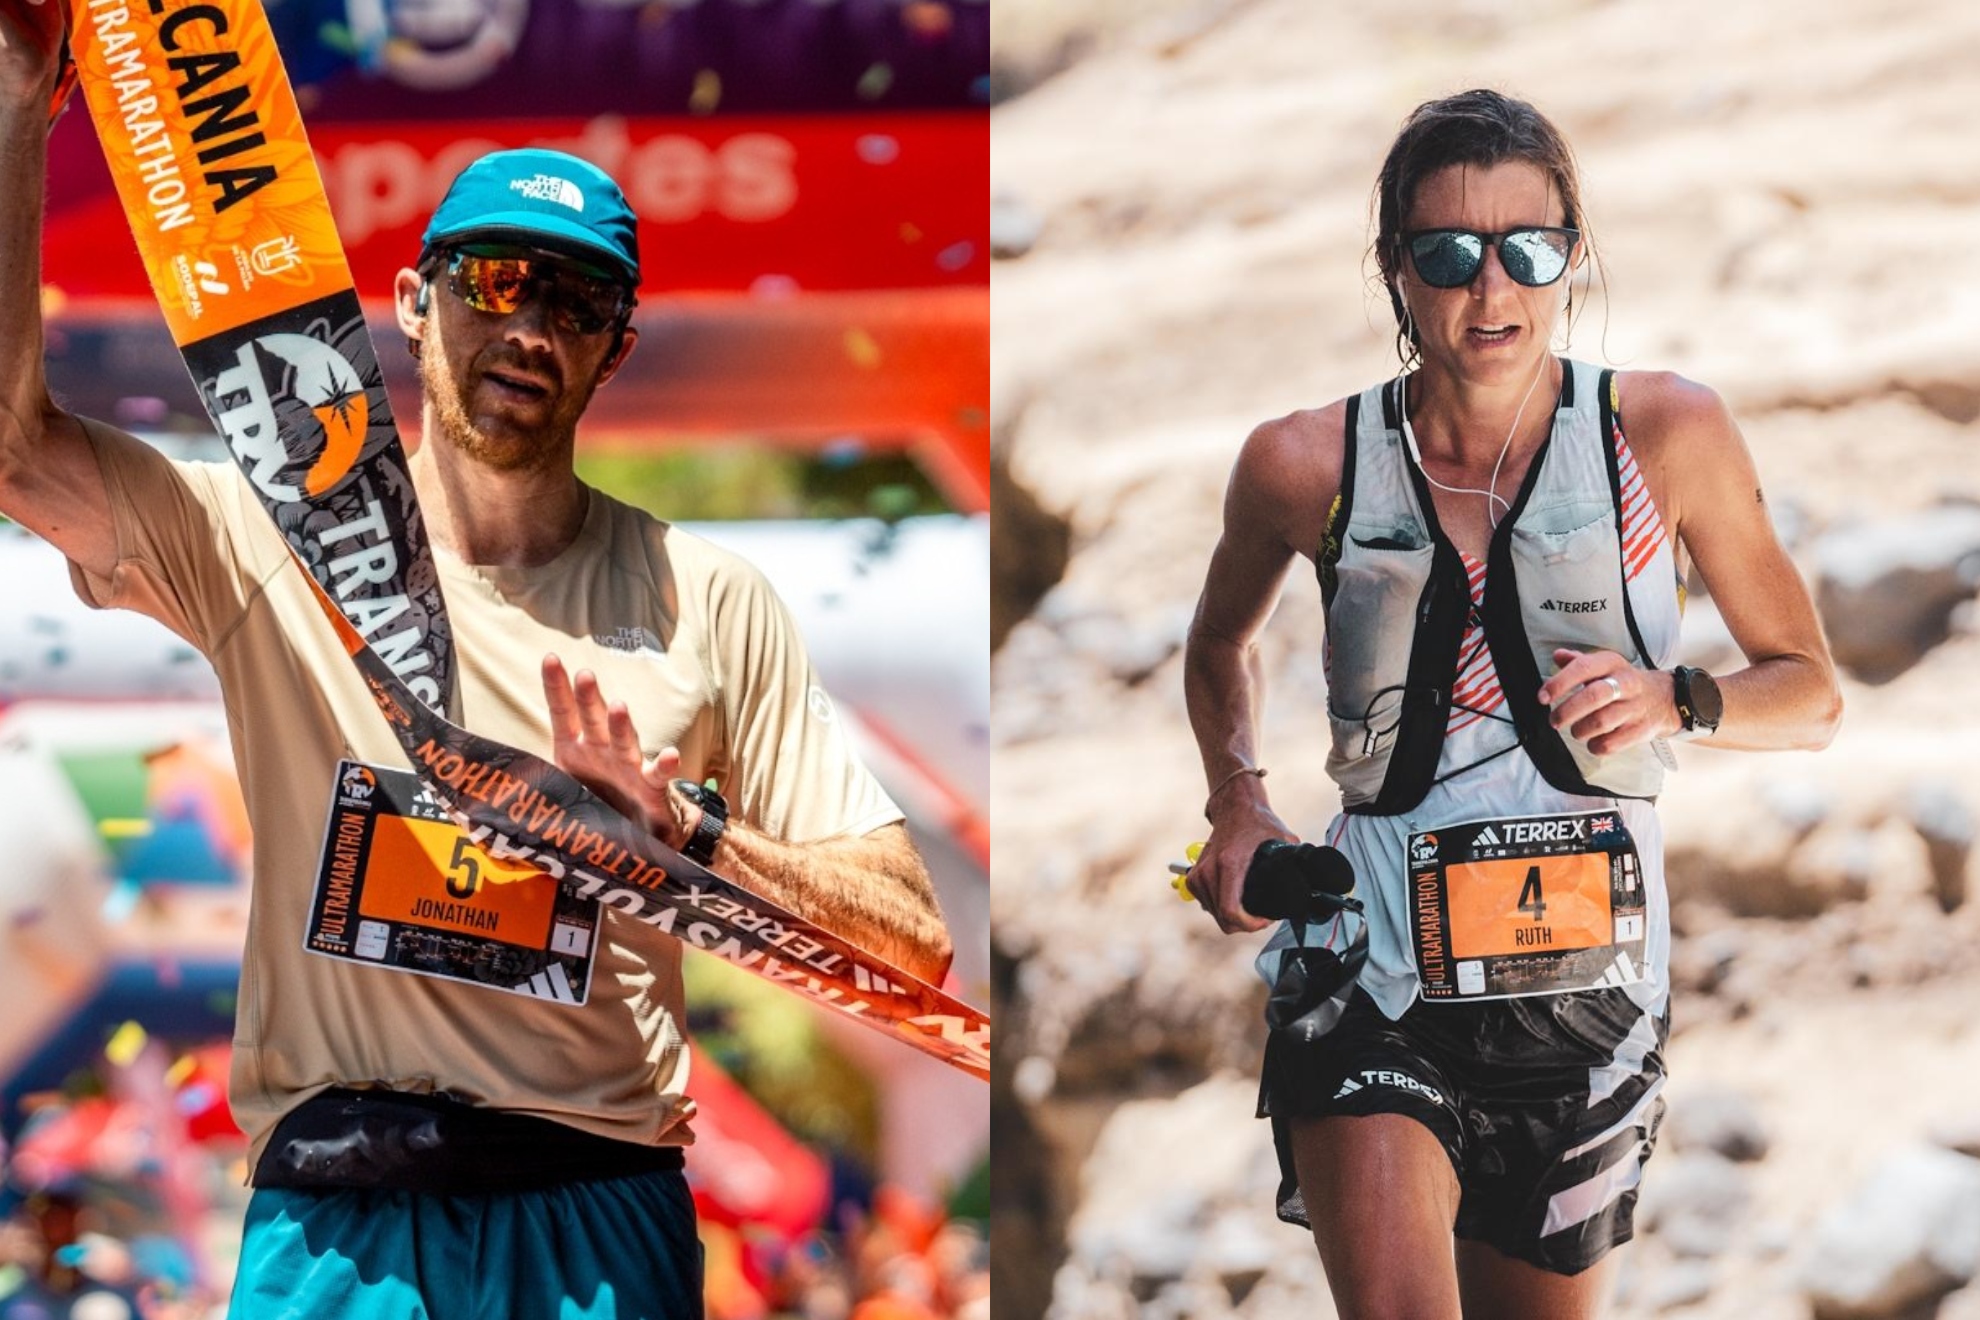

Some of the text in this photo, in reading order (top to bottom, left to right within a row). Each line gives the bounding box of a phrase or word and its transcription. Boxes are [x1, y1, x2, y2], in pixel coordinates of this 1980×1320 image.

[148, 0, 278, 214] CANIA
[176, 254, 203, 319] SODEPAL
[616, 627, 643, 638] THE
[1556, 599, 1608, 614] TERREX
[415, 738, 668, 890] ULTRAMARATHON
[1502, 820, 1586, 844] TERREX
[320, 812, 366, 936] ULTRAMARATHON
[446, 836, 480, 900] 5
[1517, 866, 1547, 922] 4
[411, 898, 499, 932] JONATHAN
[567, 931, 575, 948] 1
[672, 884, 843, 975] TERREX
[1417, 872, 1444, 983] ULTRAMARATHON
[1515, 927, 1552, 947] RUTH
